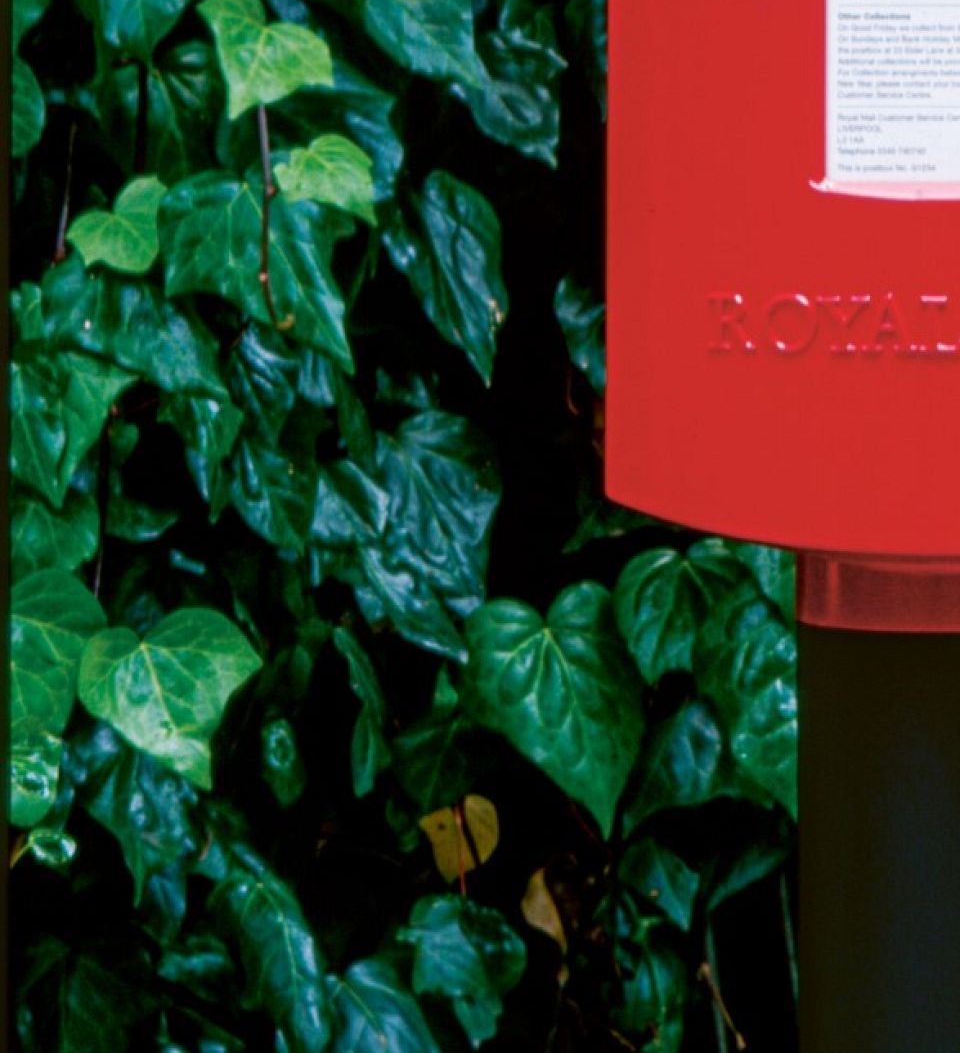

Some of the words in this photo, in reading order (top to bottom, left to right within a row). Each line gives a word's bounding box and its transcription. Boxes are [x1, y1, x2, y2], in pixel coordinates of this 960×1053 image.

[838, 12, 860, 20] Other
[864, 12, 911, 20] Collections
[850, 24, 872, 32] Good
[873, 24, 896, 34] Friday
[912, 24, 936, 32] collect
[938, 24, 955, 32] from
[851, 35, 884, 44] Sundays
[886, 35, 900, 43] and
[901, 35, 920, 43] Bank
[922, 35, 950, 44] Holiday
[851, 46, 882, 56] postbox
[838, 58, 875, 66] Additional
[878, 58, 917, 66] collections
[838, 80, 854, 88] New
[876, 80, 900, 90] please
[903, 80, 931, 88] contact
[933, 80, 949, 90] your
[838, 91, 874, 99] Customer
[876, 91, 904, 99] Service
[837, 113, 858, 122] Royal
[860, 113, 876, 121] Mail
[878, 113, 914, 121] Customer
[916, 113, 944, 121] Service
[837, 124, 881, 132] LIVERPOOL
[837, 147, 875, 156] Telephone
[837, 163, 852, 172] This
[862, 163, 894, 173] postbox
